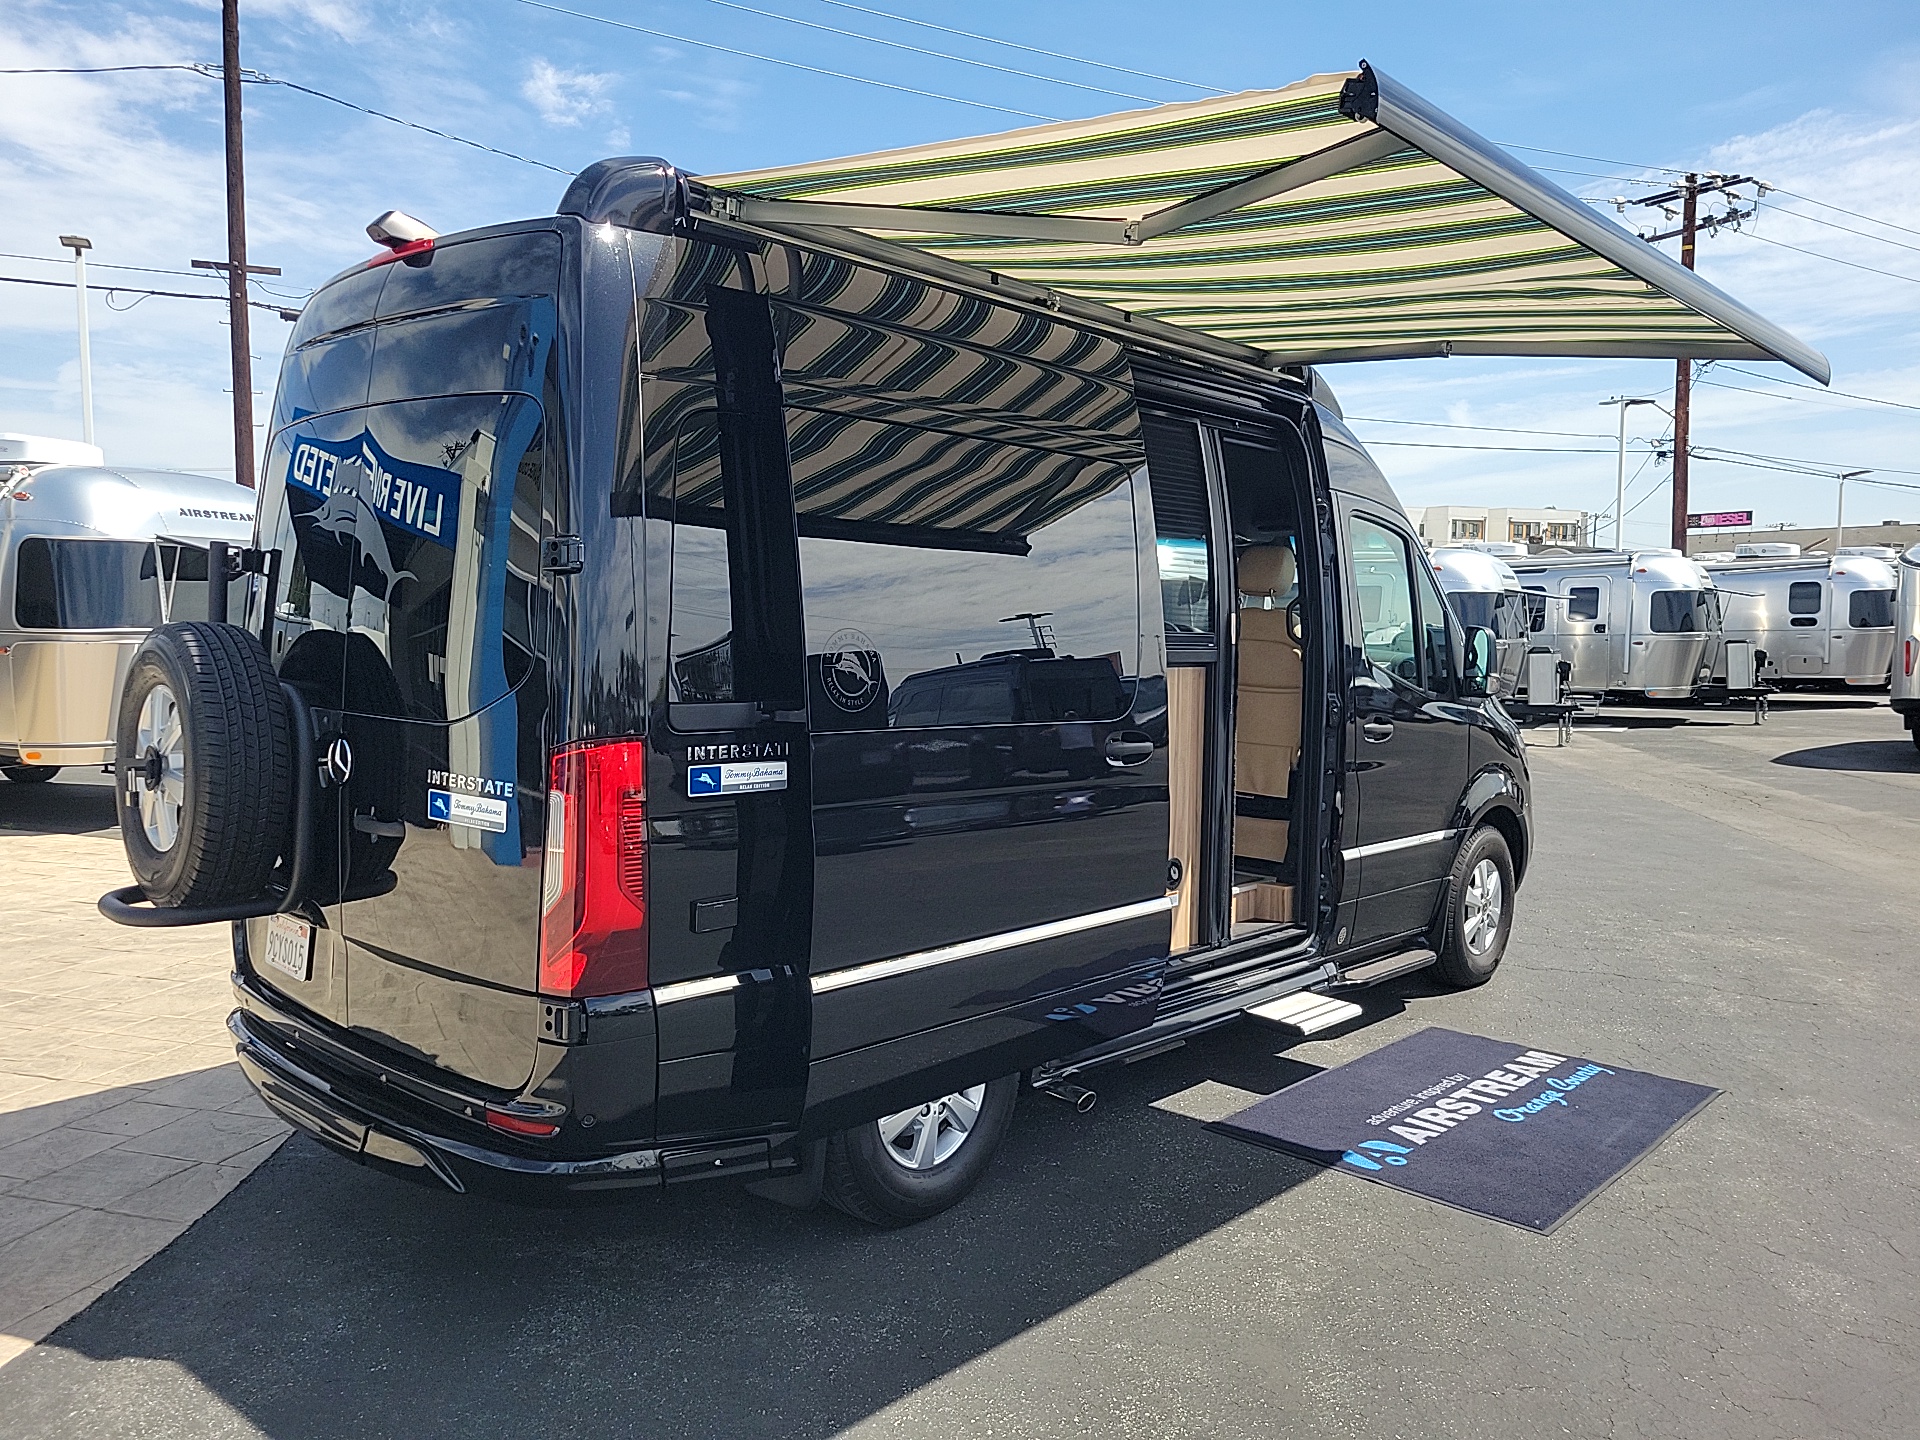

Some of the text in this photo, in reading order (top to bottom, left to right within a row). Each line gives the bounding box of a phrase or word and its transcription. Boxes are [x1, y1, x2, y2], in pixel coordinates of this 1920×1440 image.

[427, 768, 514, 798] INTERSTATE
[724, 766, 784, 781] Tommy Bahama
[454, 798, 503, 817] Tommy Bahama
[267, 930, 305, 971] 9CYS015
[1387, 1050, 1568, 1146] AIRSTREAM
[1492, 1063, 1616, 1123] Orange County
